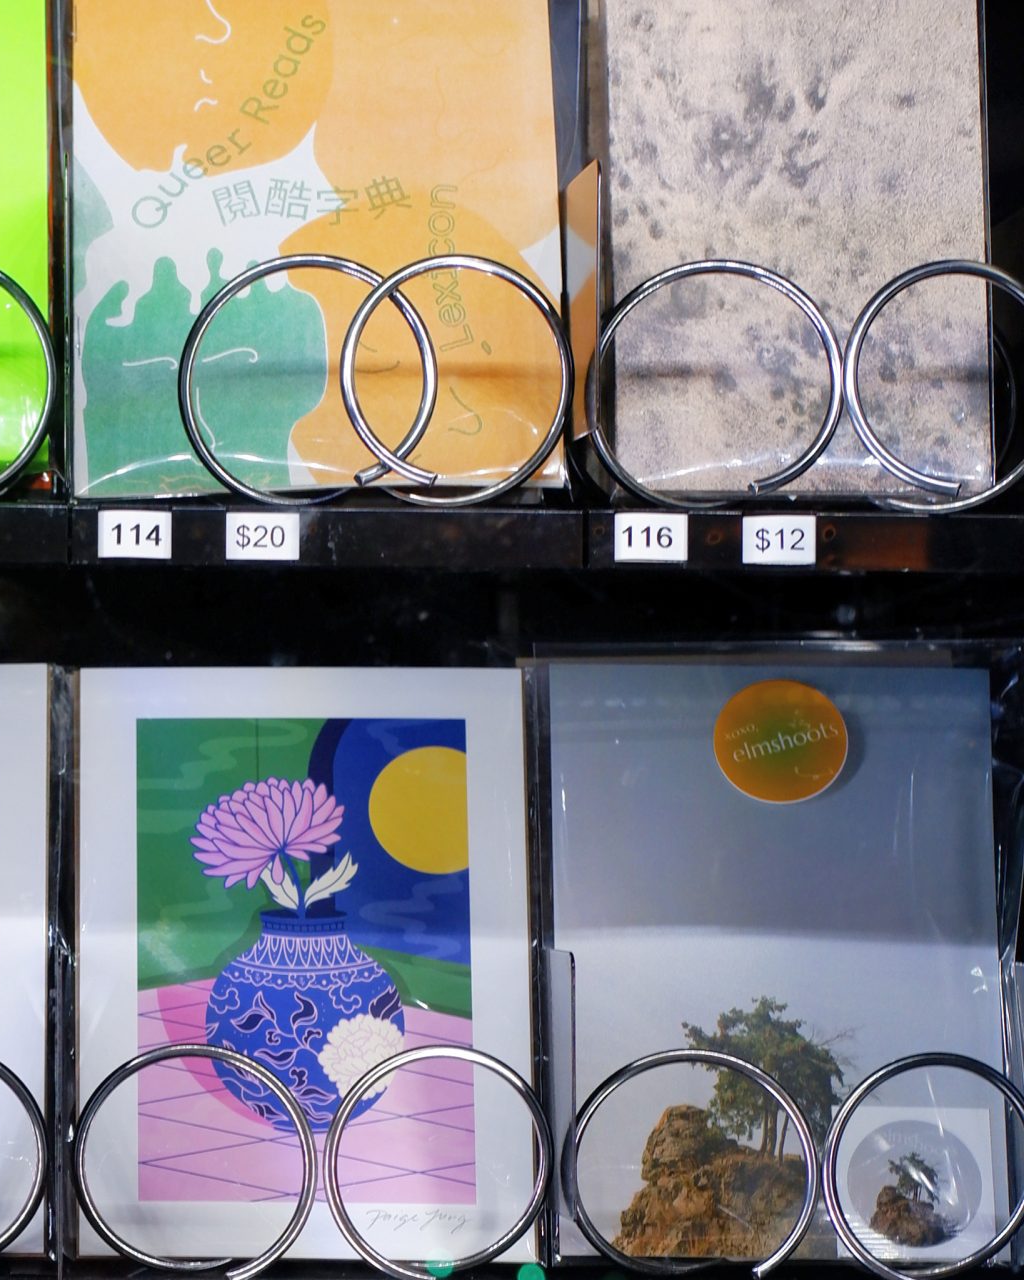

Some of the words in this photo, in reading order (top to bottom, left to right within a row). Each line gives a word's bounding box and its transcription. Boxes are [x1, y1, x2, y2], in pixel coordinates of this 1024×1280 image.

[132, 130, 253, 228] Queer
[242, 13, 326, 124] Reads
[428, 184, 474, 352] Lexicon
[112, 524, 160, 545] 114
[236, 525, 284, 549] $20
[623, 526, 672, 547] 116
[756, 529, 804, 552] $12
[733, 722, 839, 762] elmshoots
